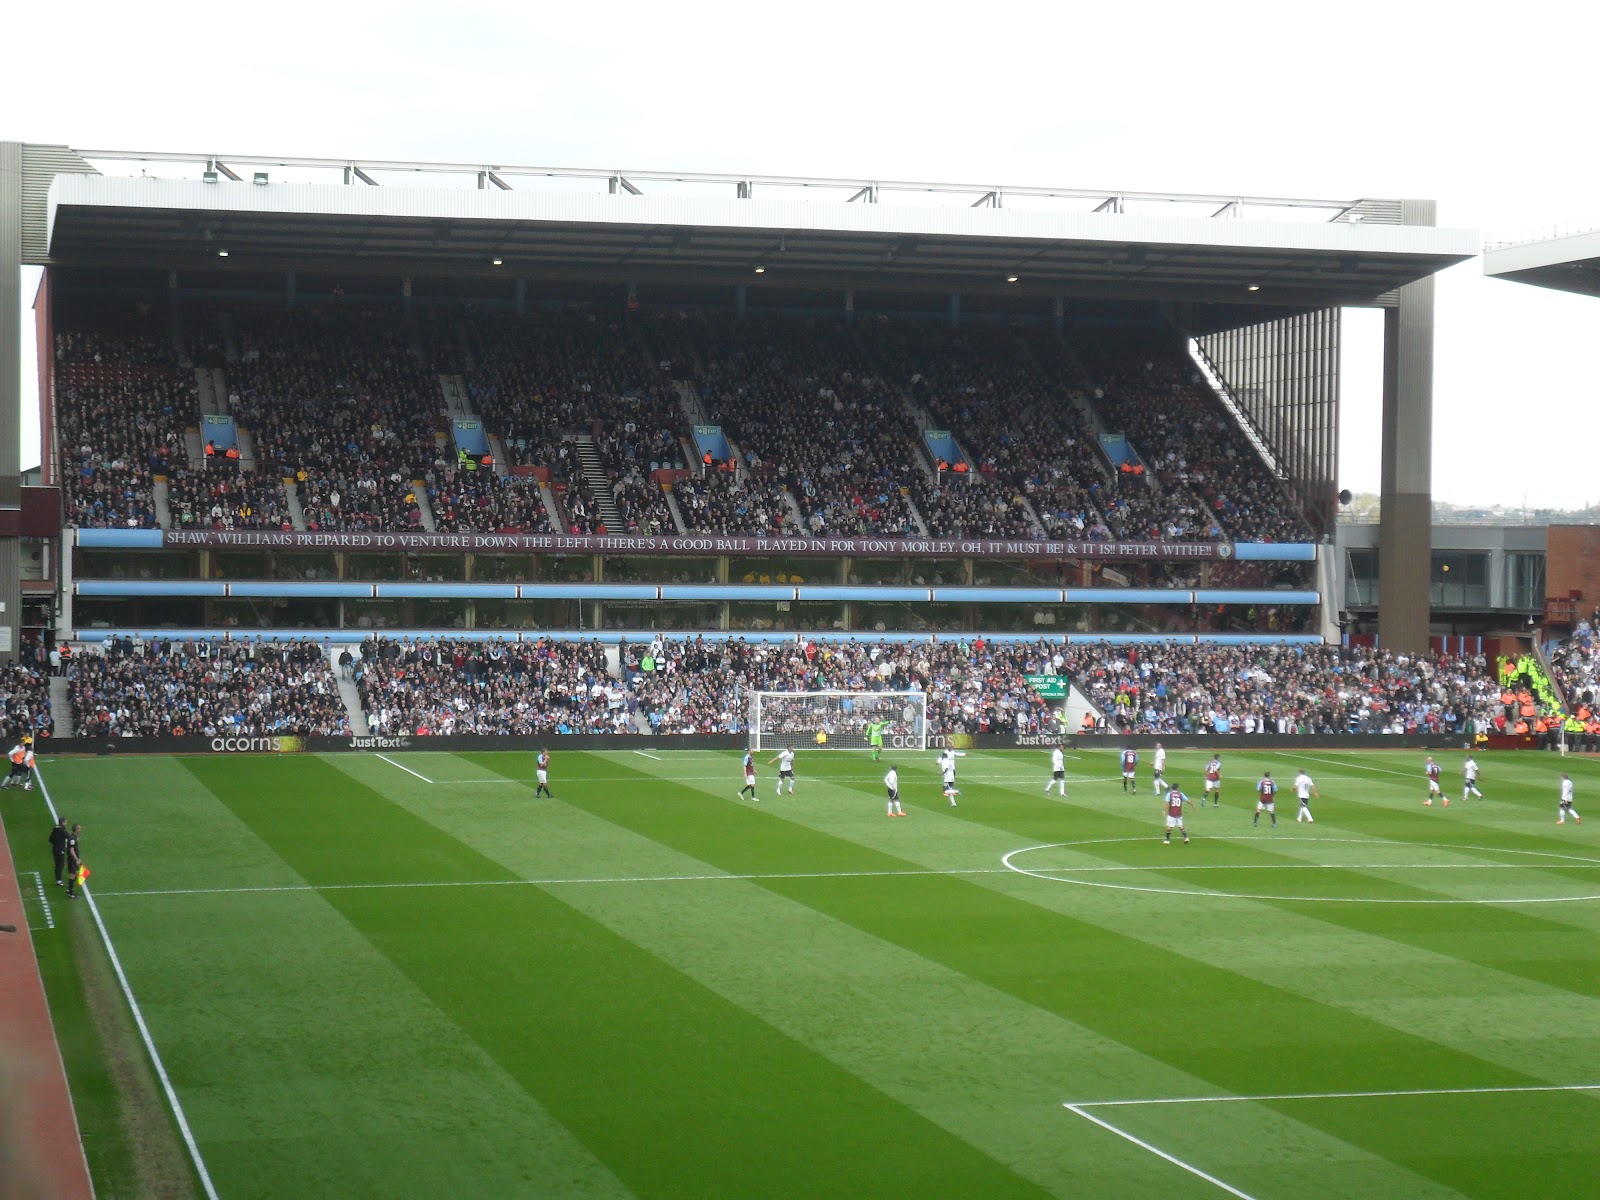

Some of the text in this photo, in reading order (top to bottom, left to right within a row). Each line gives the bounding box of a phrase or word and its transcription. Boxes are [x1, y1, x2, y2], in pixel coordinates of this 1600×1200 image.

[168, 532, 1212, 556] SHAW, WILLIAMS PREPARED TO VENTURE DOWN THE LEFT. THERE'S A GOOD BALL PLAYED IN FOR TONY MORLEY. OH, IT MUST BE! & IT IS!! PETER WITHE!!
[211, 737, 281, 752] acorns
[1263, 785, 1272, 794] 31
[1171, 797, 1181, 807] 30
